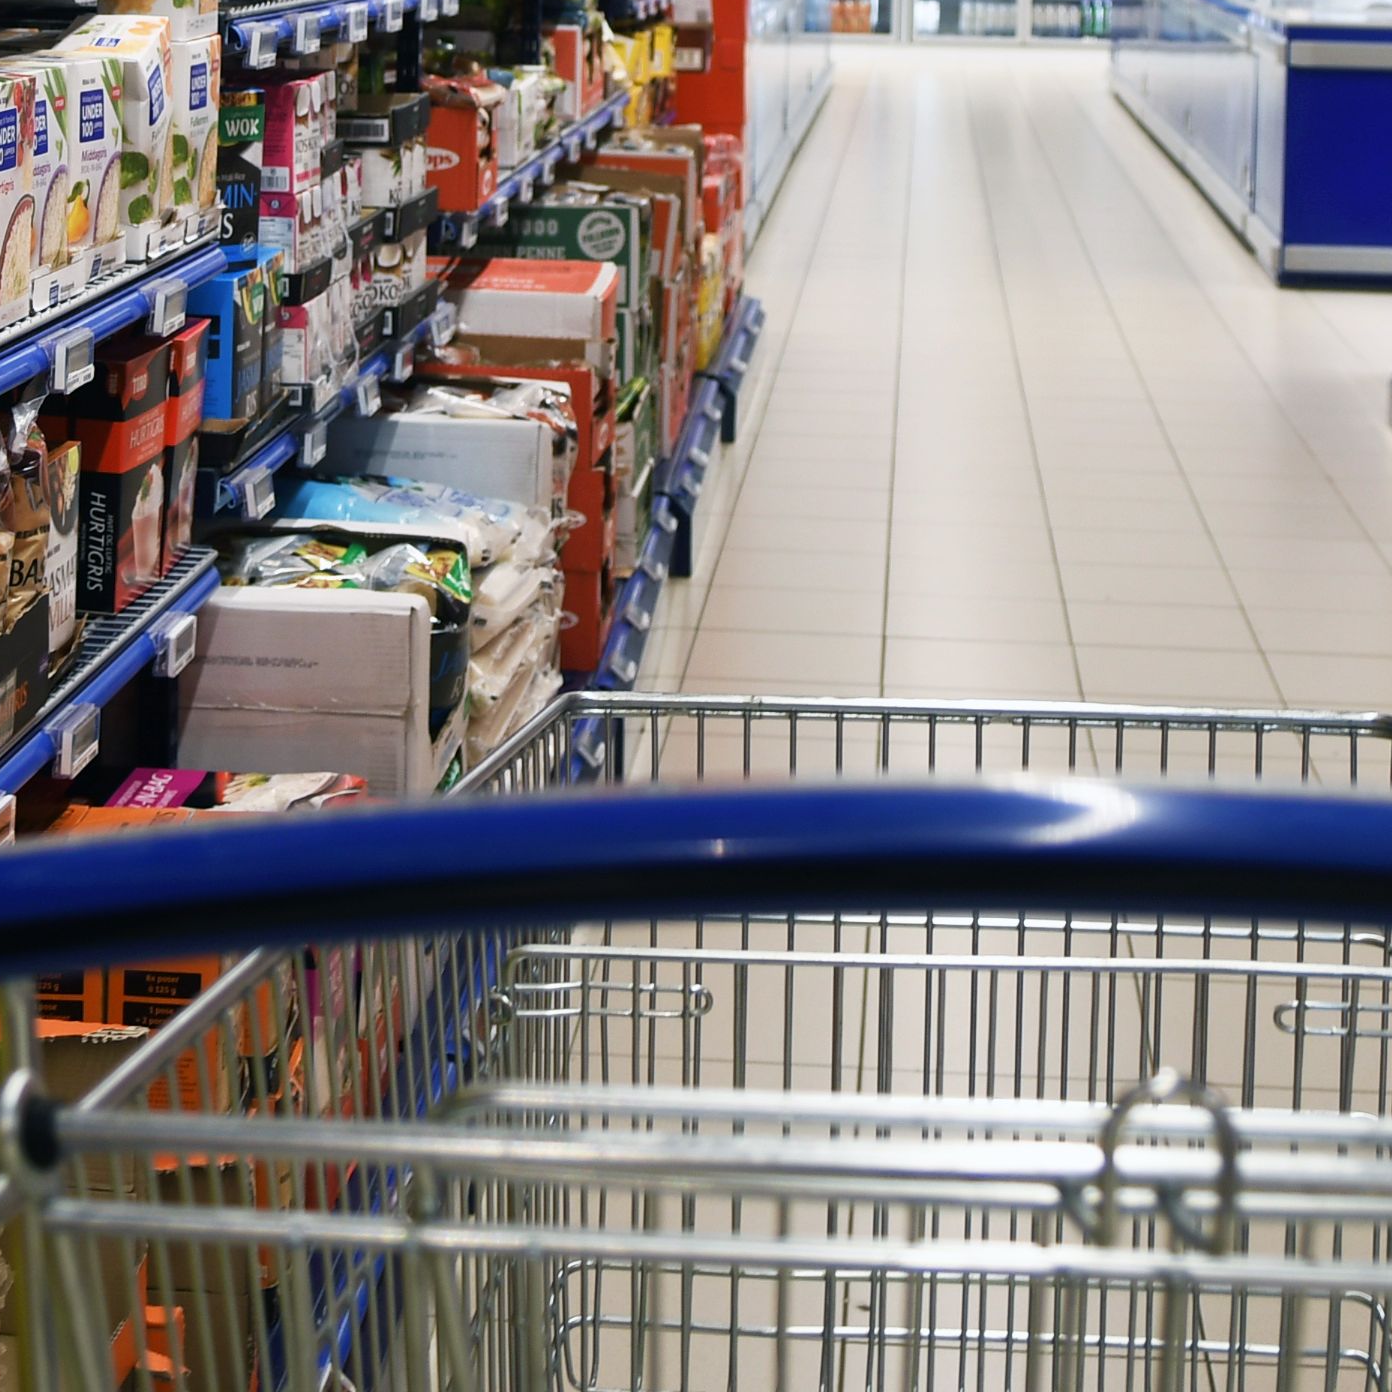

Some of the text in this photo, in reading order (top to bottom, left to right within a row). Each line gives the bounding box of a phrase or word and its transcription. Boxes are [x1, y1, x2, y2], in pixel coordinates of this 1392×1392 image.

[80, 104, 104, 122] UNDER
[80, 121, 94, 139] 100
[225, 117, 261, 138] WOK
[86, 491, 108, 593] HURTIGRIS
